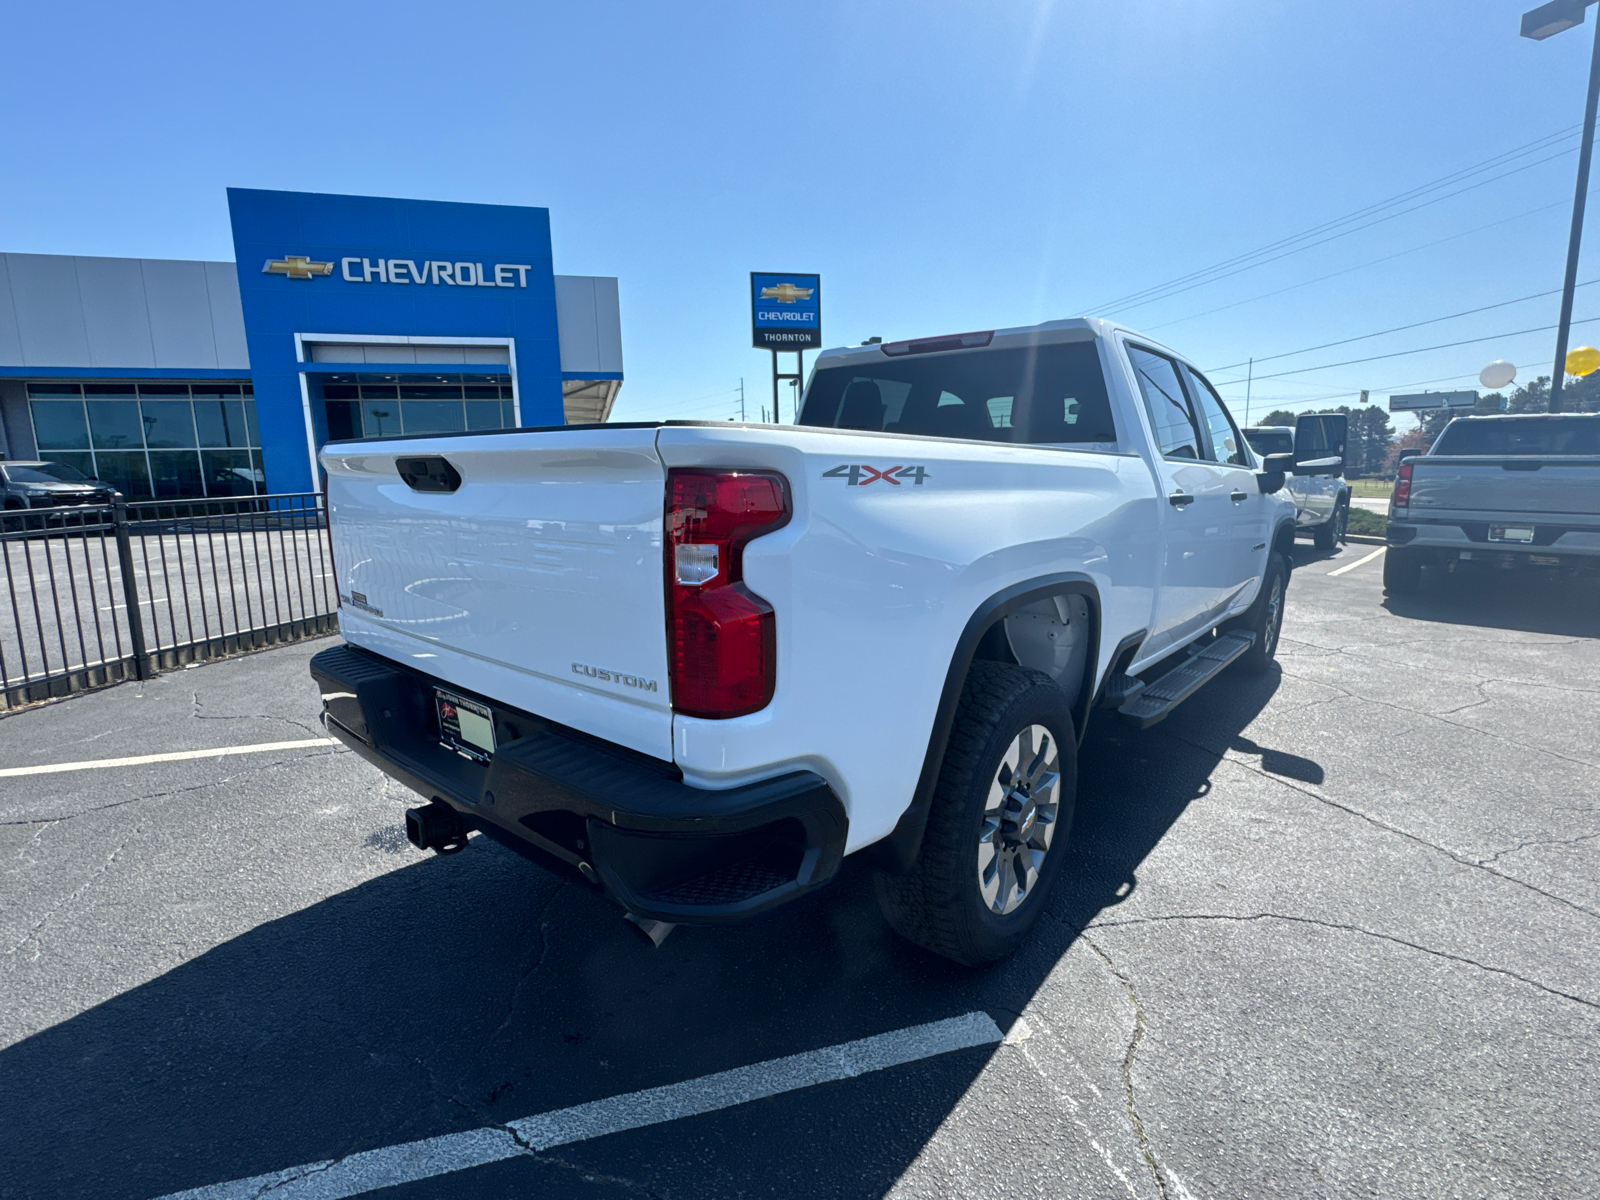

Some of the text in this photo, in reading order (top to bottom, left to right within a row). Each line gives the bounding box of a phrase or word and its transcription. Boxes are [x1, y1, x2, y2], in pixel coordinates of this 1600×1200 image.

[341, 257, 531, 288] CHEVROLET
[758, 312, 815, 321] CHEVROLET
[764, 333, 811, 341] THORNTON
[571, 662, 658, 692] CUSTOM
